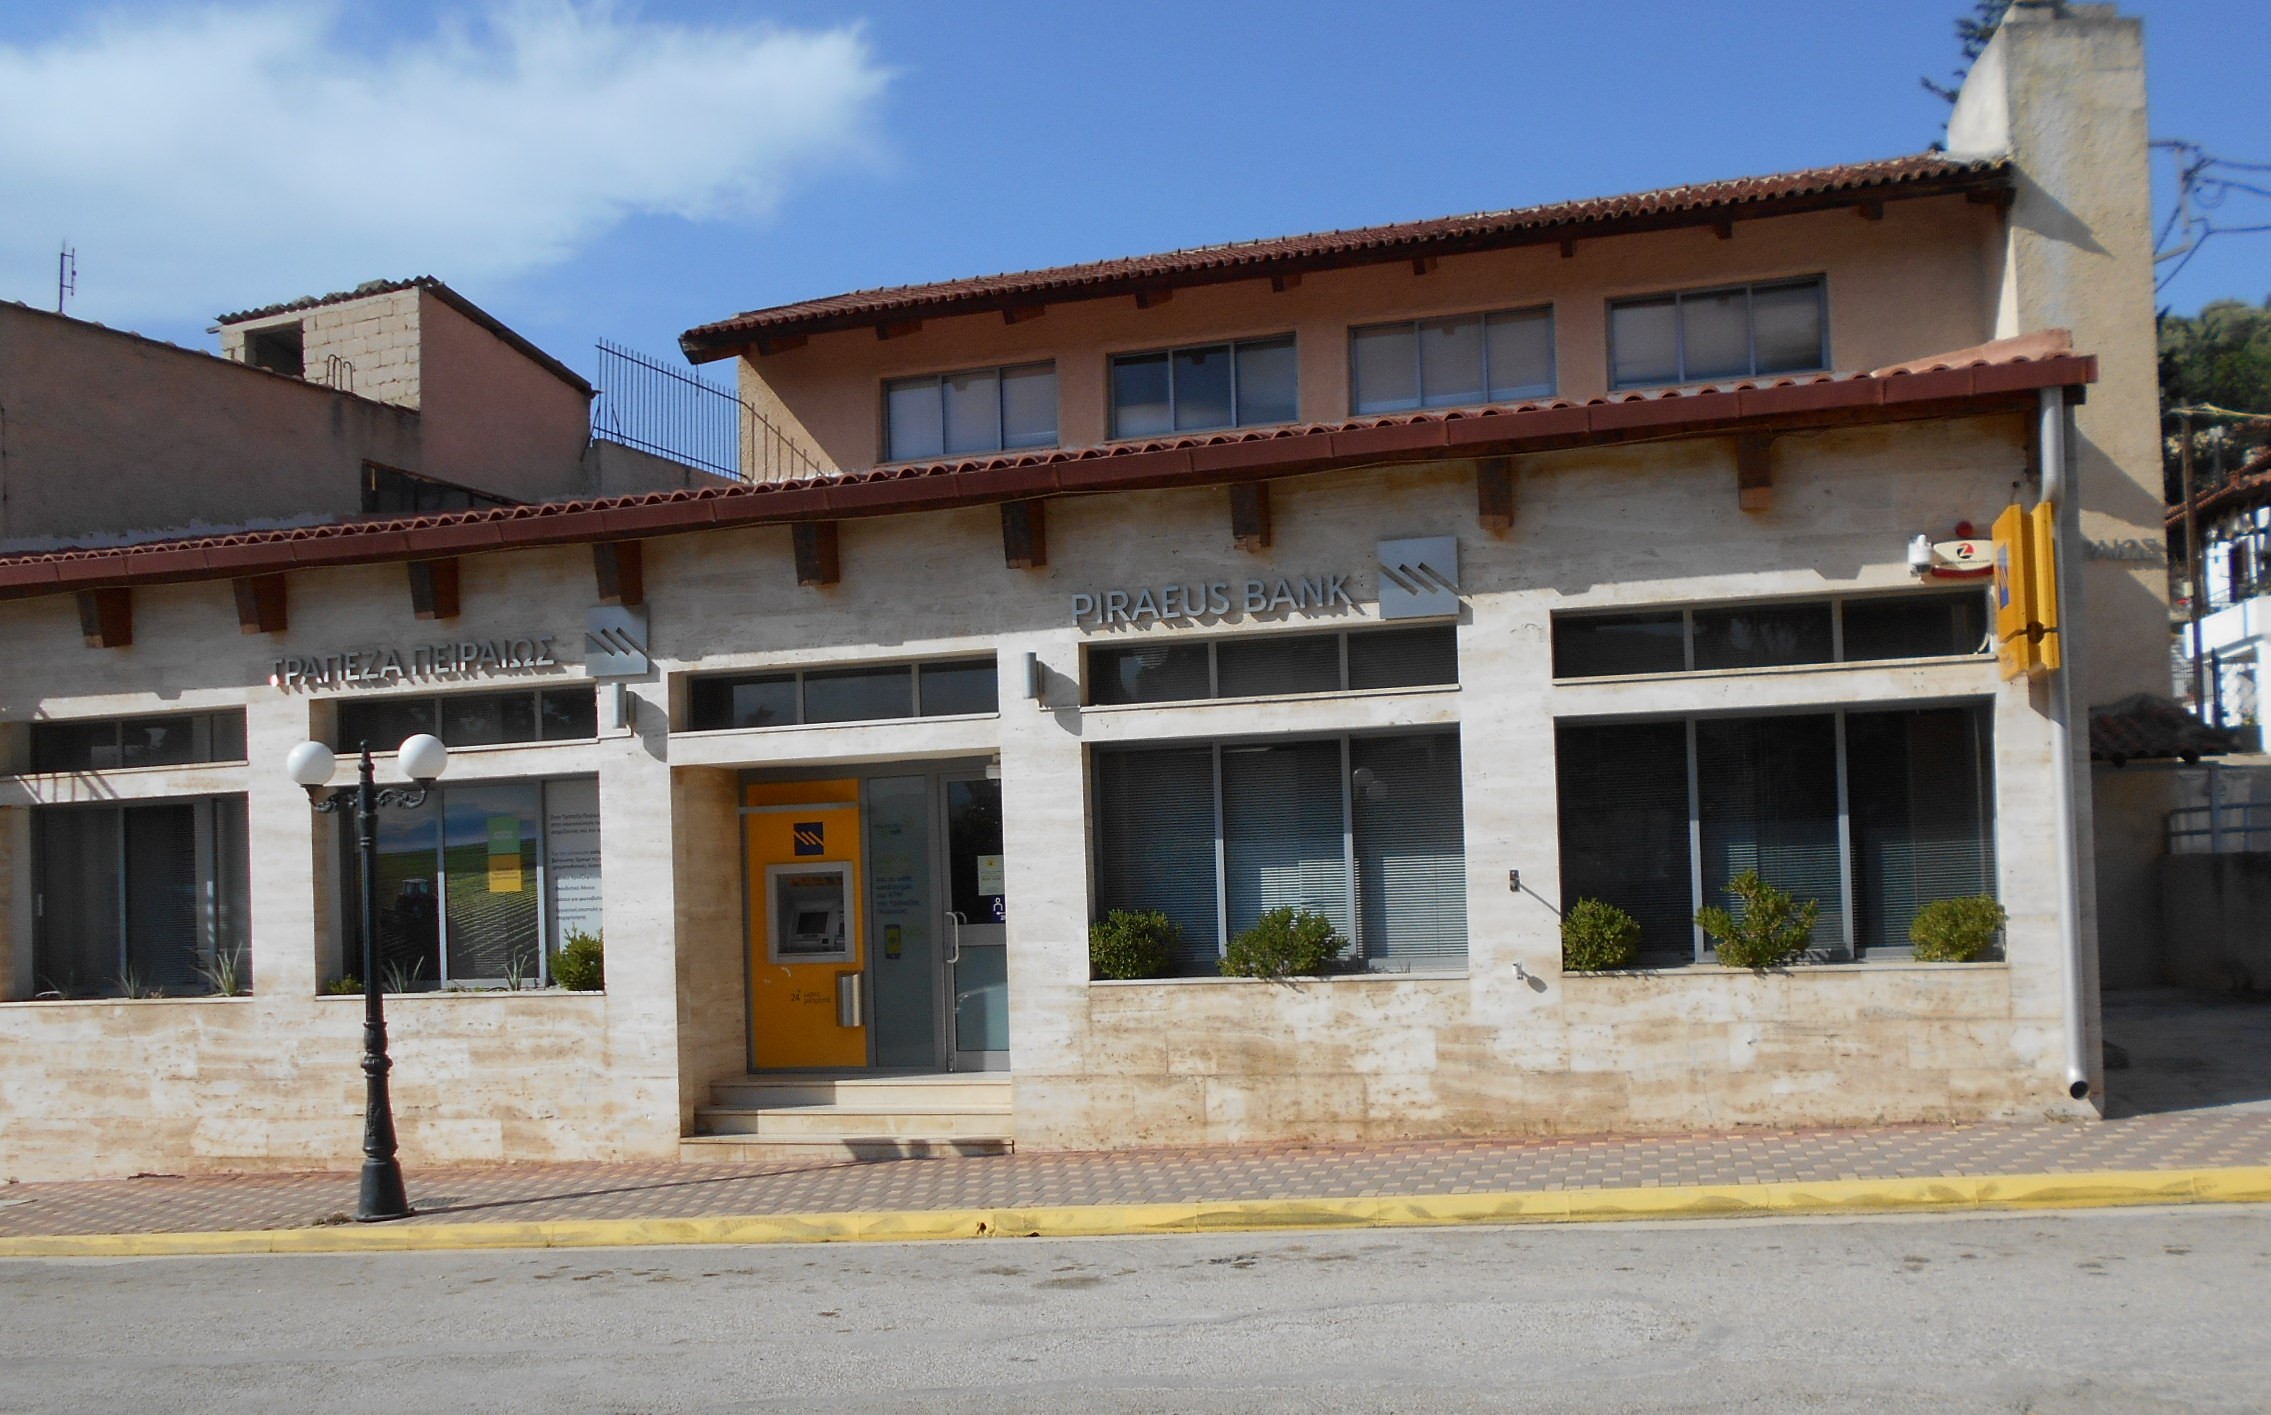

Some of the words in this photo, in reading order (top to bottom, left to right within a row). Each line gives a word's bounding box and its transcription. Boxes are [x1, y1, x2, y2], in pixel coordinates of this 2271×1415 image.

[1071, 582, 1231, 626] PIRAEUS
[1243, 574, 1354, 614] BANK
[271, 648, 402, 687] ΤΡΑΠΕΖΑ
[411, 635, 555, 676] ΠΕΙΡΑΙΩΣ
